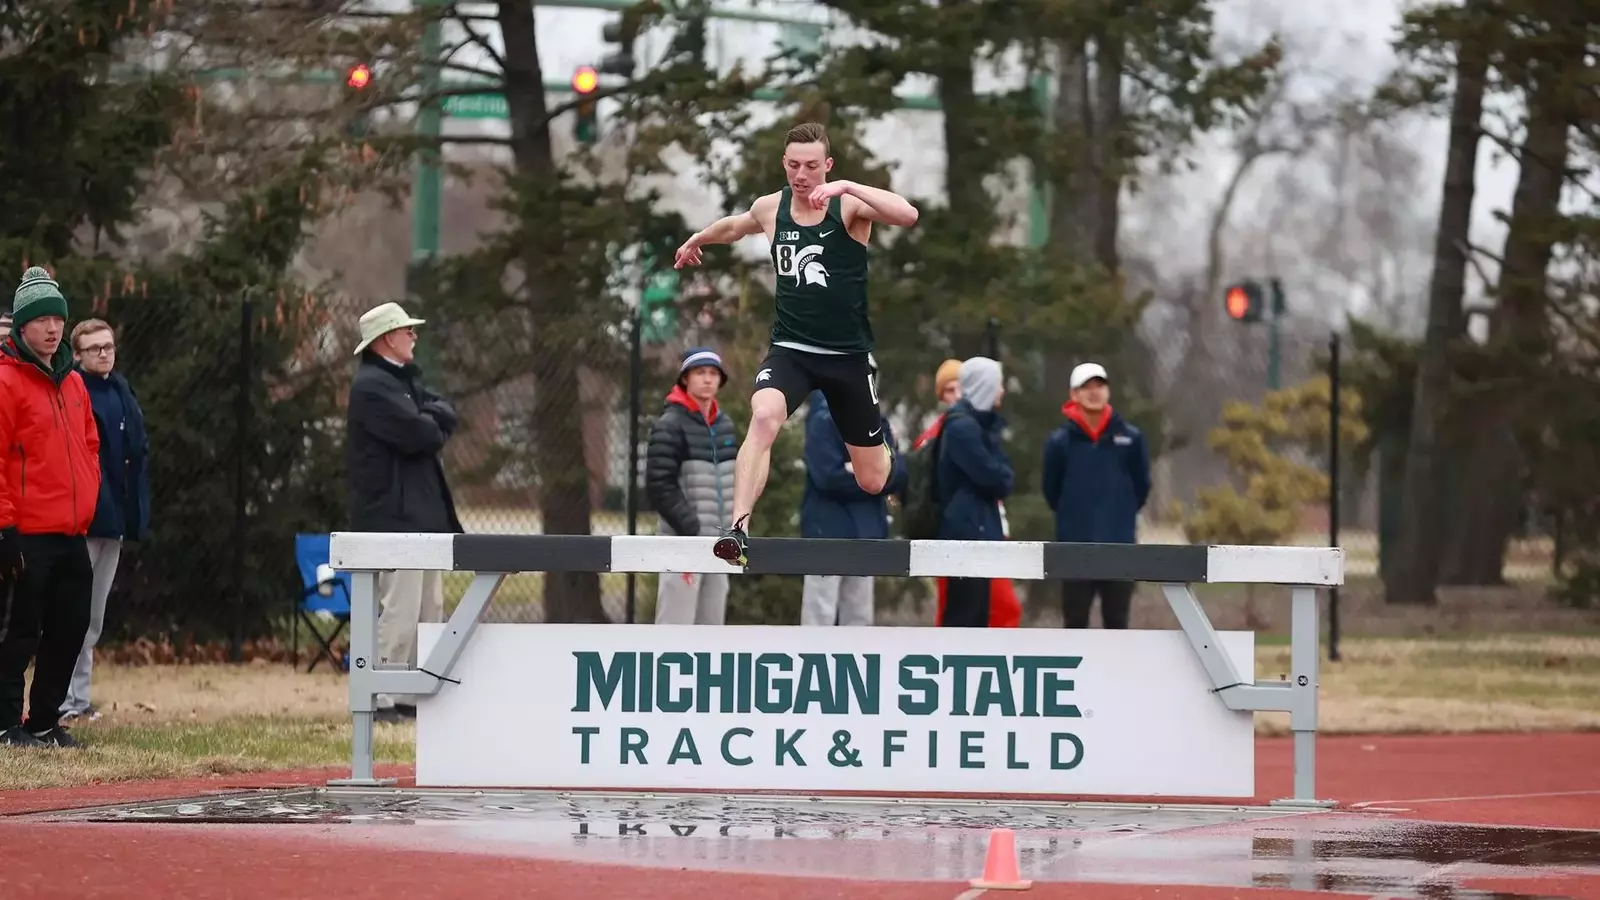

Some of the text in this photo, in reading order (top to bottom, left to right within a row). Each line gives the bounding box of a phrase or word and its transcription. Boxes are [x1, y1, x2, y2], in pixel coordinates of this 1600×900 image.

[780, 246, 792, 273] 8
[570, 651, 1083, 717] MICHIGAN STATE
